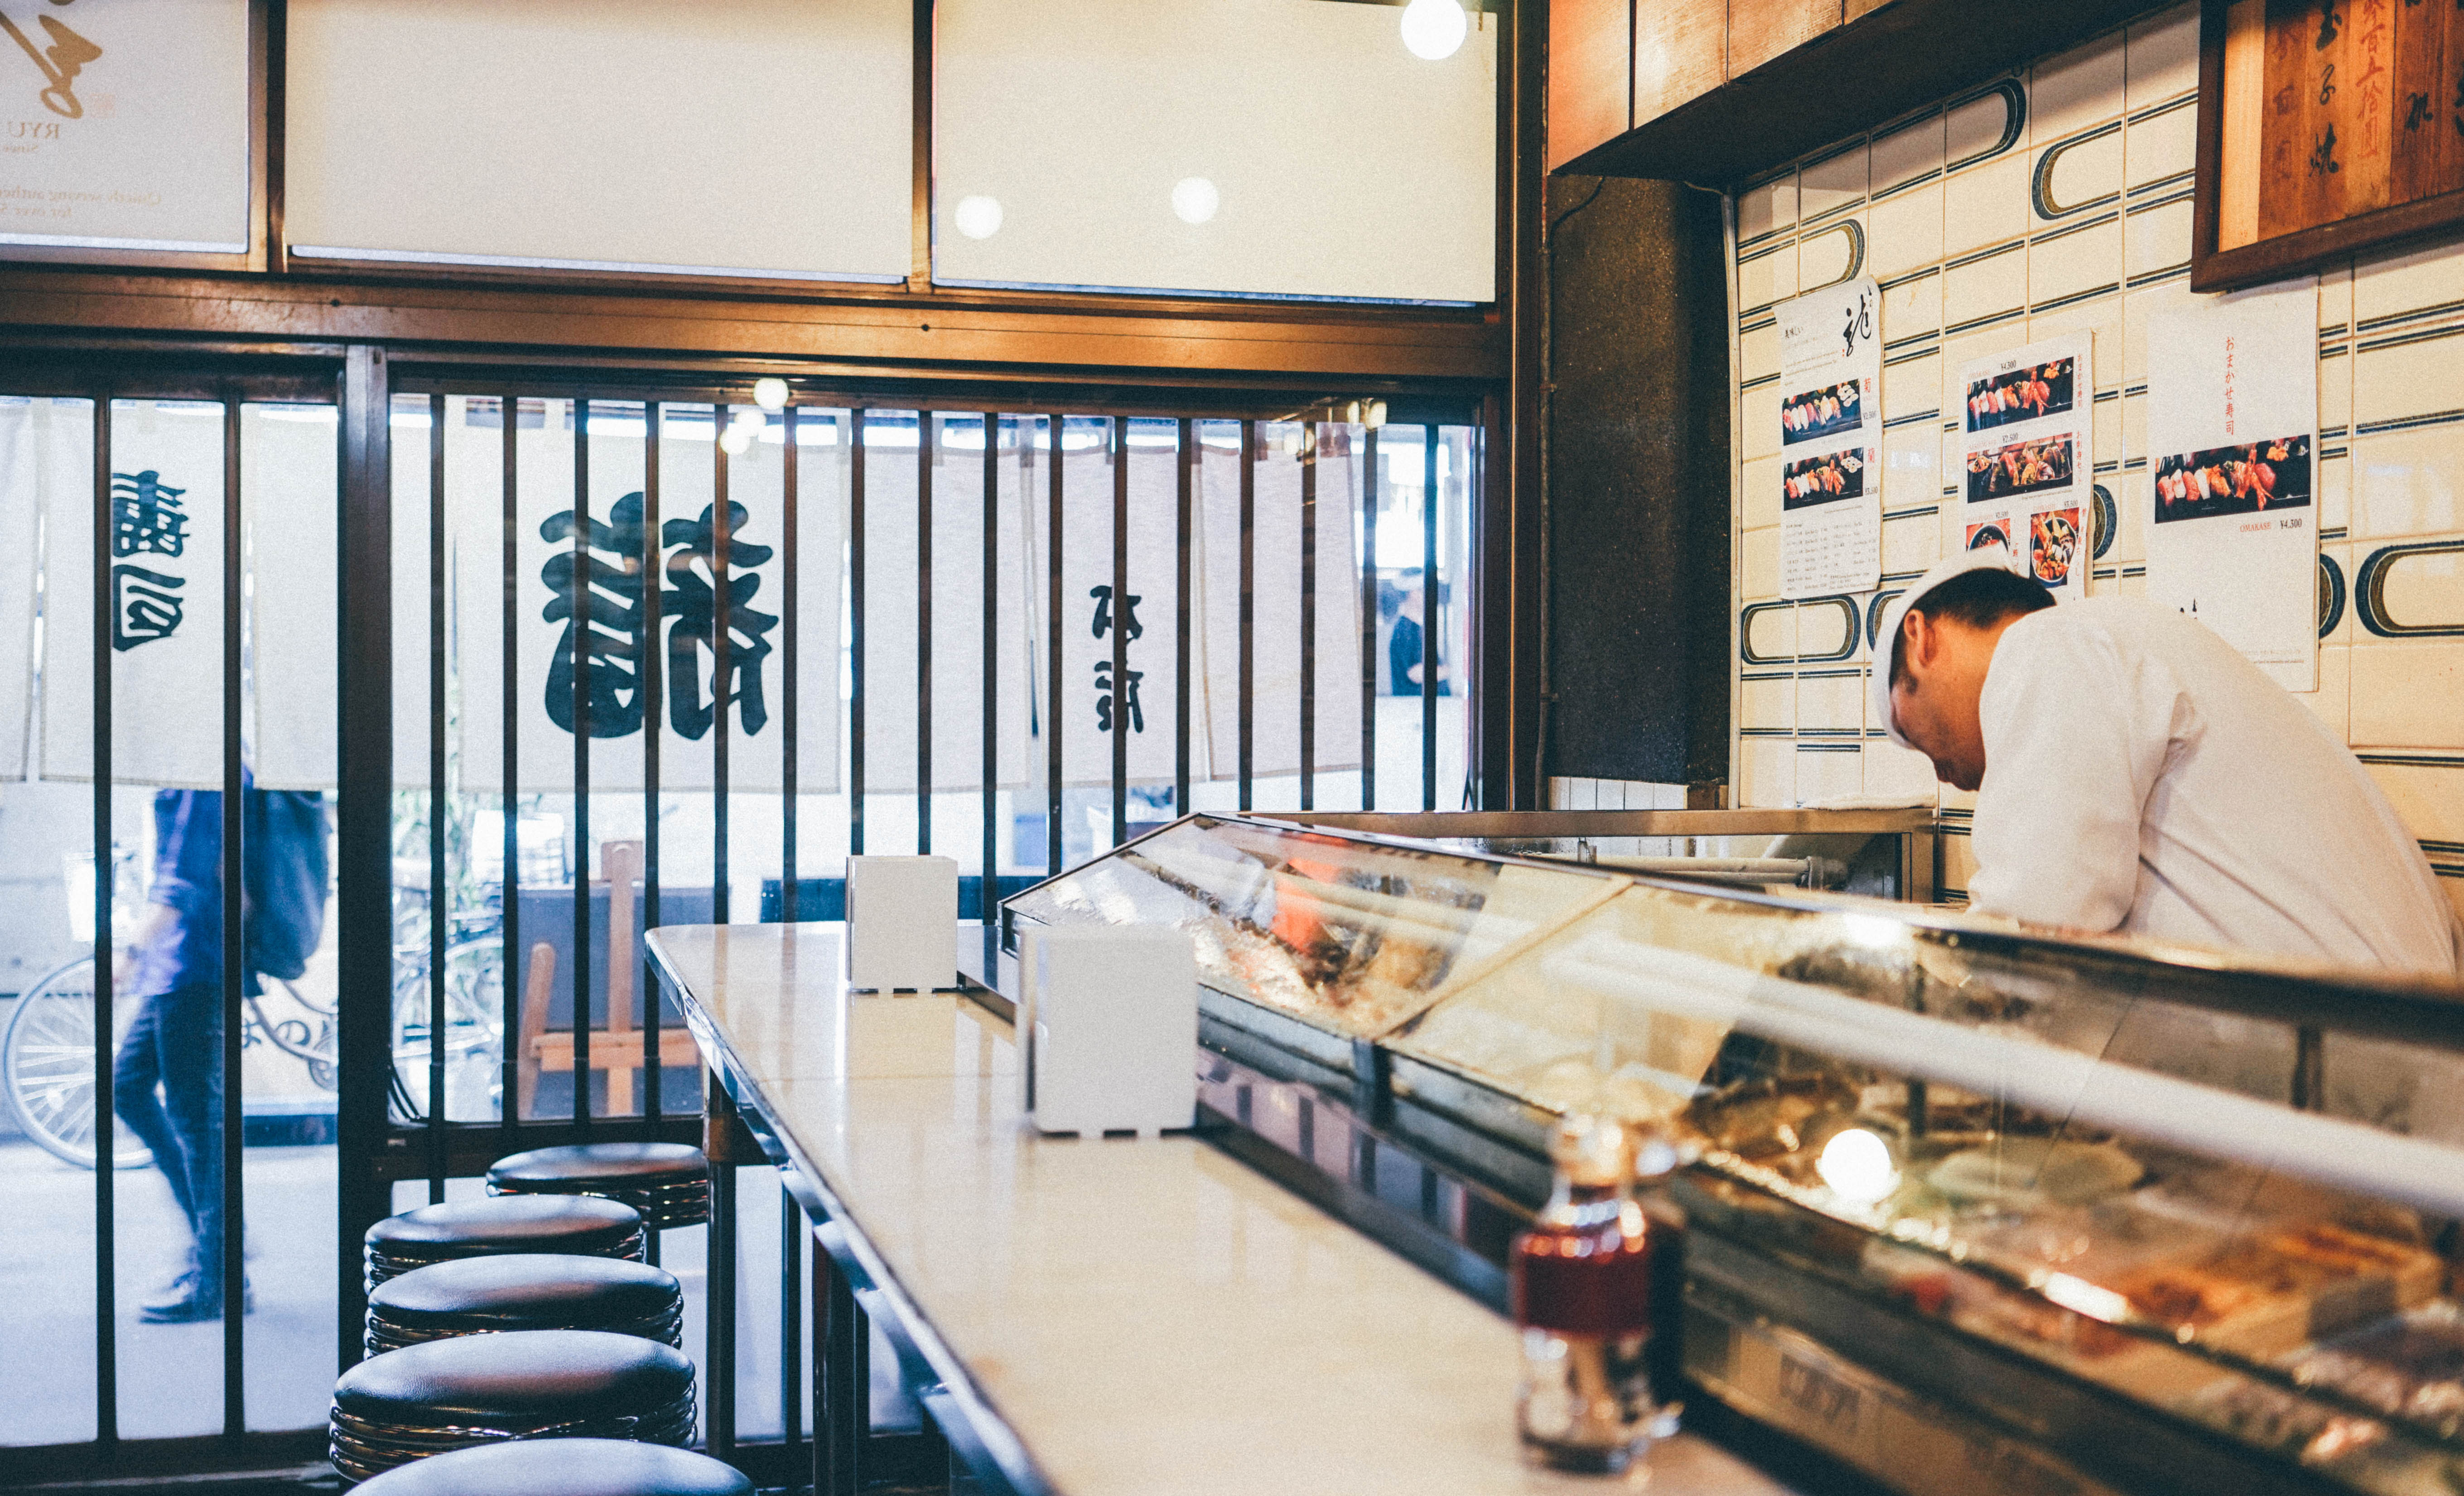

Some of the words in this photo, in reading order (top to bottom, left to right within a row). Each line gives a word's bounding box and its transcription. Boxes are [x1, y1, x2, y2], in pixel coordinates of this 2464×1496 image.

[2224, 336, 2235, 436] おまかせ寿司
[2240, 522, 2271, 533] OMAKASE
